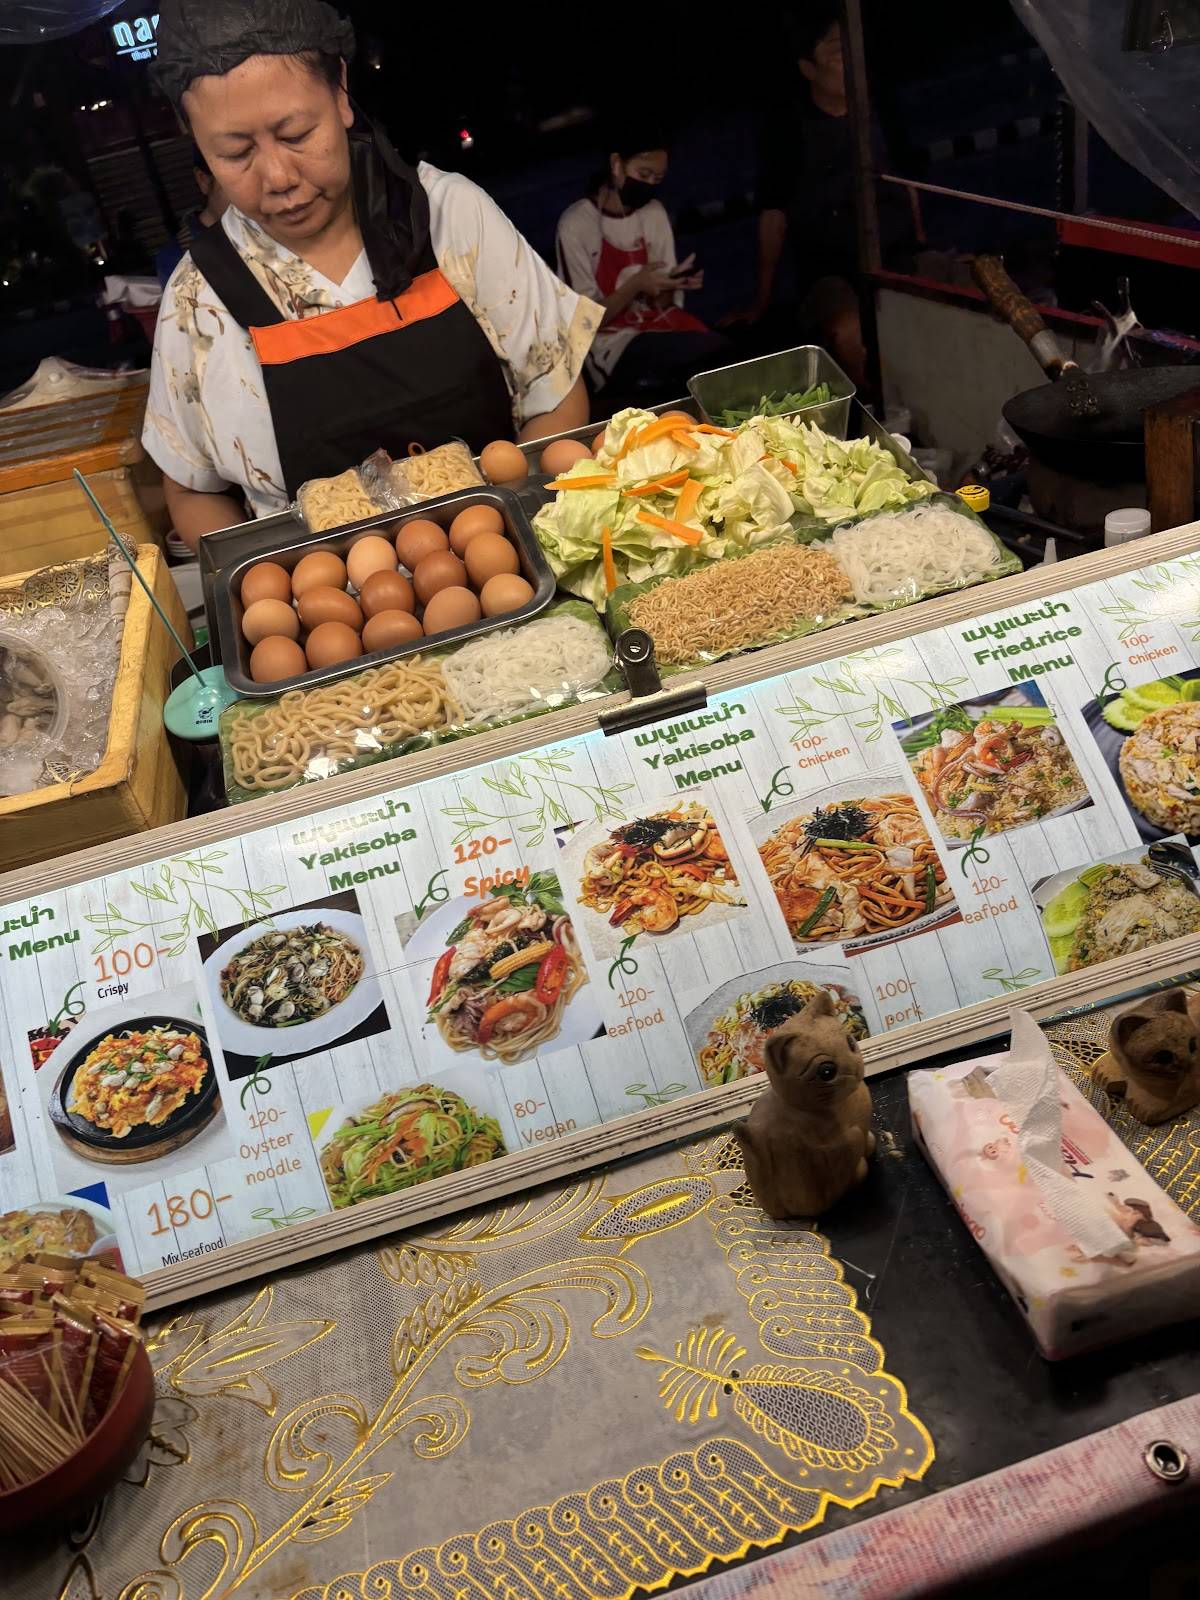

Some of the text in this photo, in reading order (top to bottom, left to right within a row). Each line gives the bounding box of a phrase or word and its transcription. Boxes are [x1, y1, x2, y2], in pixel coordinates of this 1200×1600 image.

[961, 601, 1071, 642] เมนูแนะนำ
[974, 626, 1082, 665] Fried.rice
[1128, 645, 1178, 665] Chicken
[1007, 654, 1075, 682] Menu
[634, 702, 746, 747] เมนูแนะนำ
[643, 728, 755, 770] Yakisoba
[798, 746, 850, 768] Chicken
[674, 759, 743, 789] Menu
[299, 828, 417, 870] Yakisoba
[454, 836, 512, 864] 120-
[329, 861, 400, 891] Menu
[464, 866, 529, 899] Spicy
[9, 930, 80, 960] Menu
[94, 943, 171, 982] 100-
[97, 982, 129, 999] Crispy
[885, 1002, 924, 1030] pork
[521, 1118, 576, 1144] Vegan
[240, 1133, 294, 1160] Oyster
[246, 1157, 302, 1185] noodle
[147, 1188, 232, 1235] 180-
